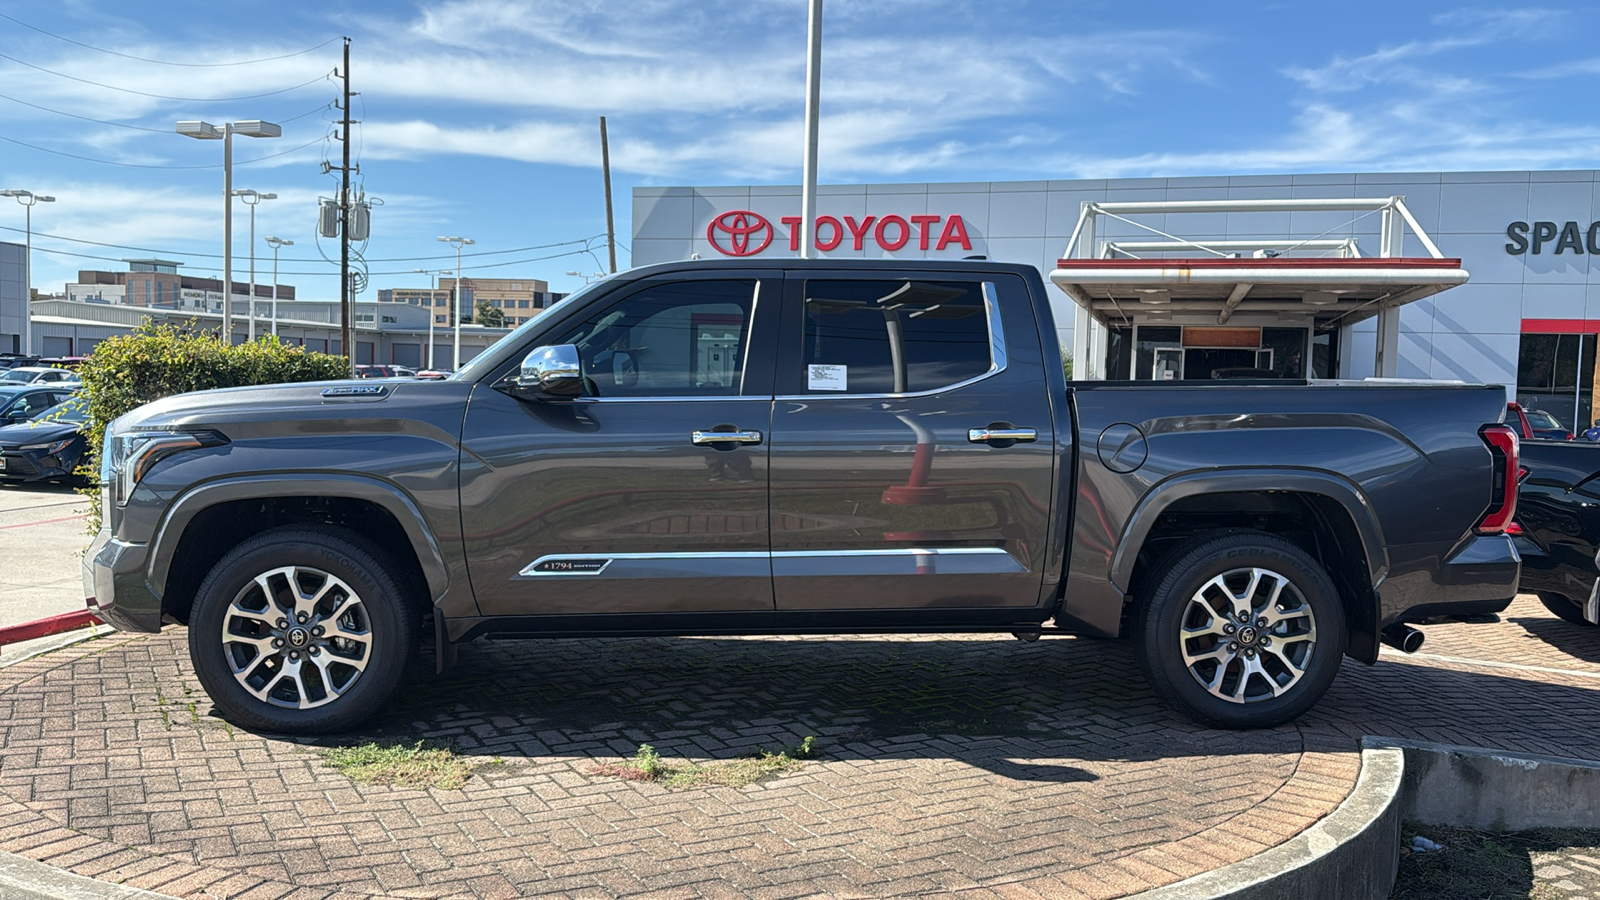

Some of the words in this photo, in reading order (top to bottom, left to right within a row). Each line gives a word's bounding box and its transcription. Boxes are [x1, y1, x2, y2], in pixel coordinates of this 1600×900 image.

[781, 214, 972, 251] TOYOTA
[320, 548, 376, 592] YOKOHAMA
[551, 562, 572, 570] 1794
